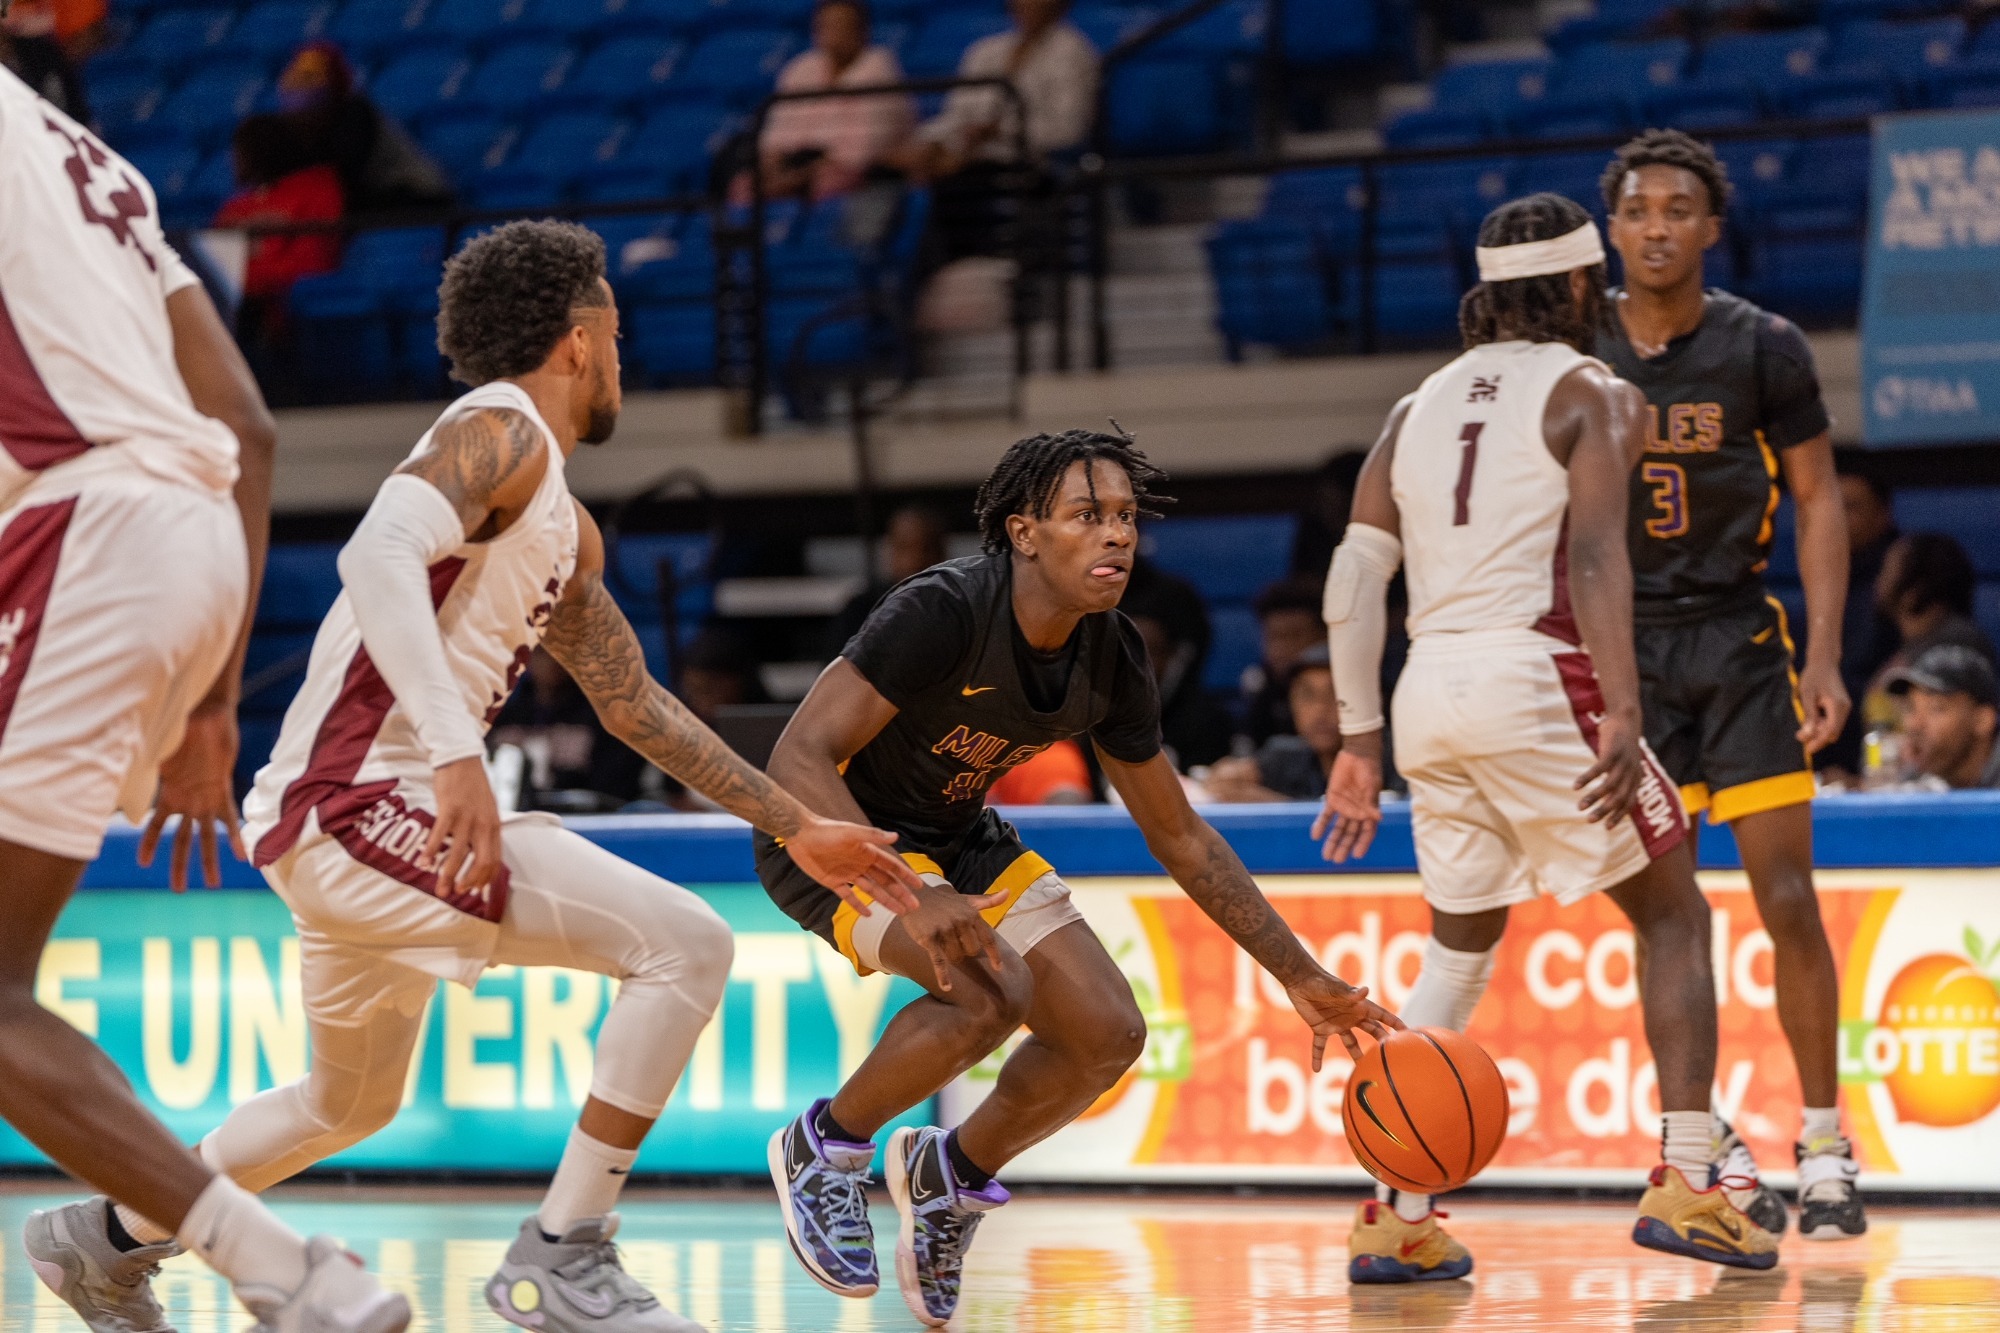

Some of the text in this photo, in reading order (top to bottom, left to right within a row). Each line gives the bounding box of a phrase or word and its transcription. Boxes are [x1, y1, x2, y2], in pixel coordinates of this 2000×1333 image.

[1645, 402, 1723, 454] LES
[1452, 422, 1486, 526] 1
[1642, 461, 1690, 539] 3
[141, 931, 894, 1111] UNERITY
